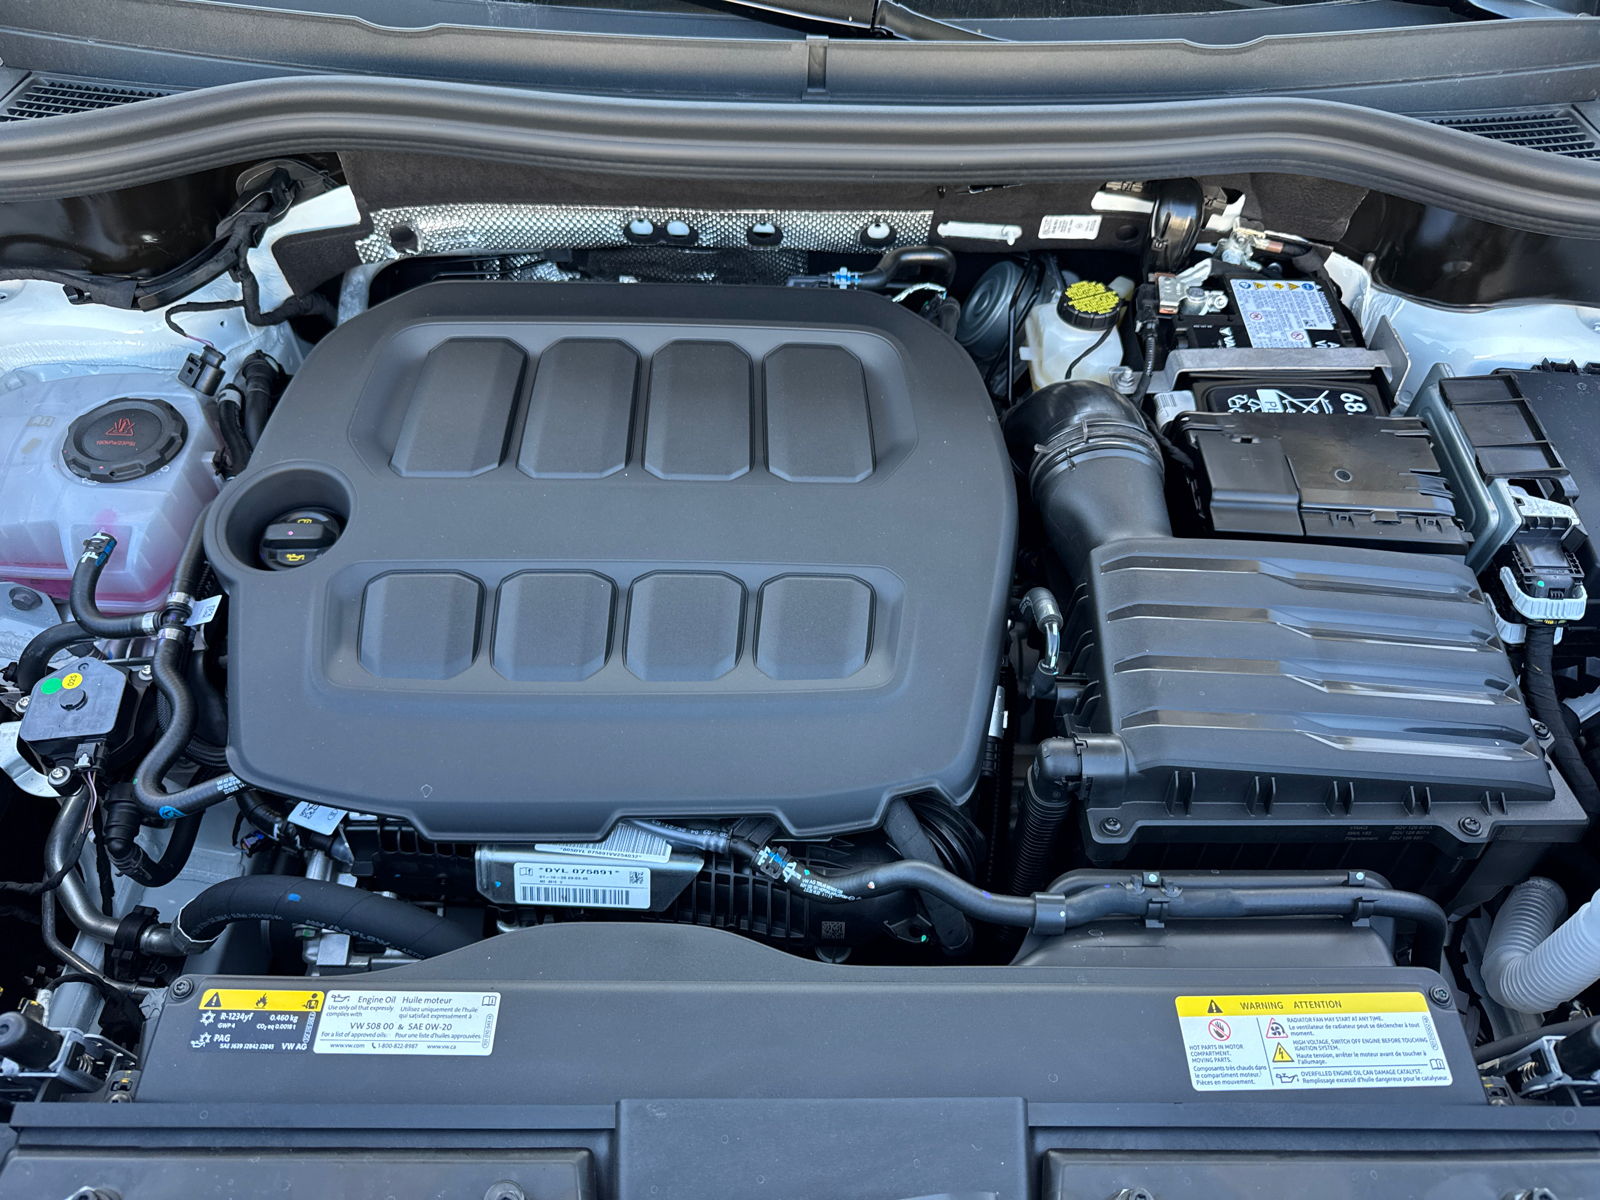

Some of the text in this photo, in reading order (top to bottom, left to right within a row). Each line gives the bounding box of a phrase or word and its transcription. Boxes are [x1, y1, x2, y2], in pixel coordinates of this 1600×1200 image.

[68, 674, 78, 687] 025
[358, 996, 383, 1005] Engine
[1240, 1000, 1342, 1011] WARNING ATTENTION
[220, 1012, 254, 1022] R-1234yf
[290, 1014, 298, 1023] kg
